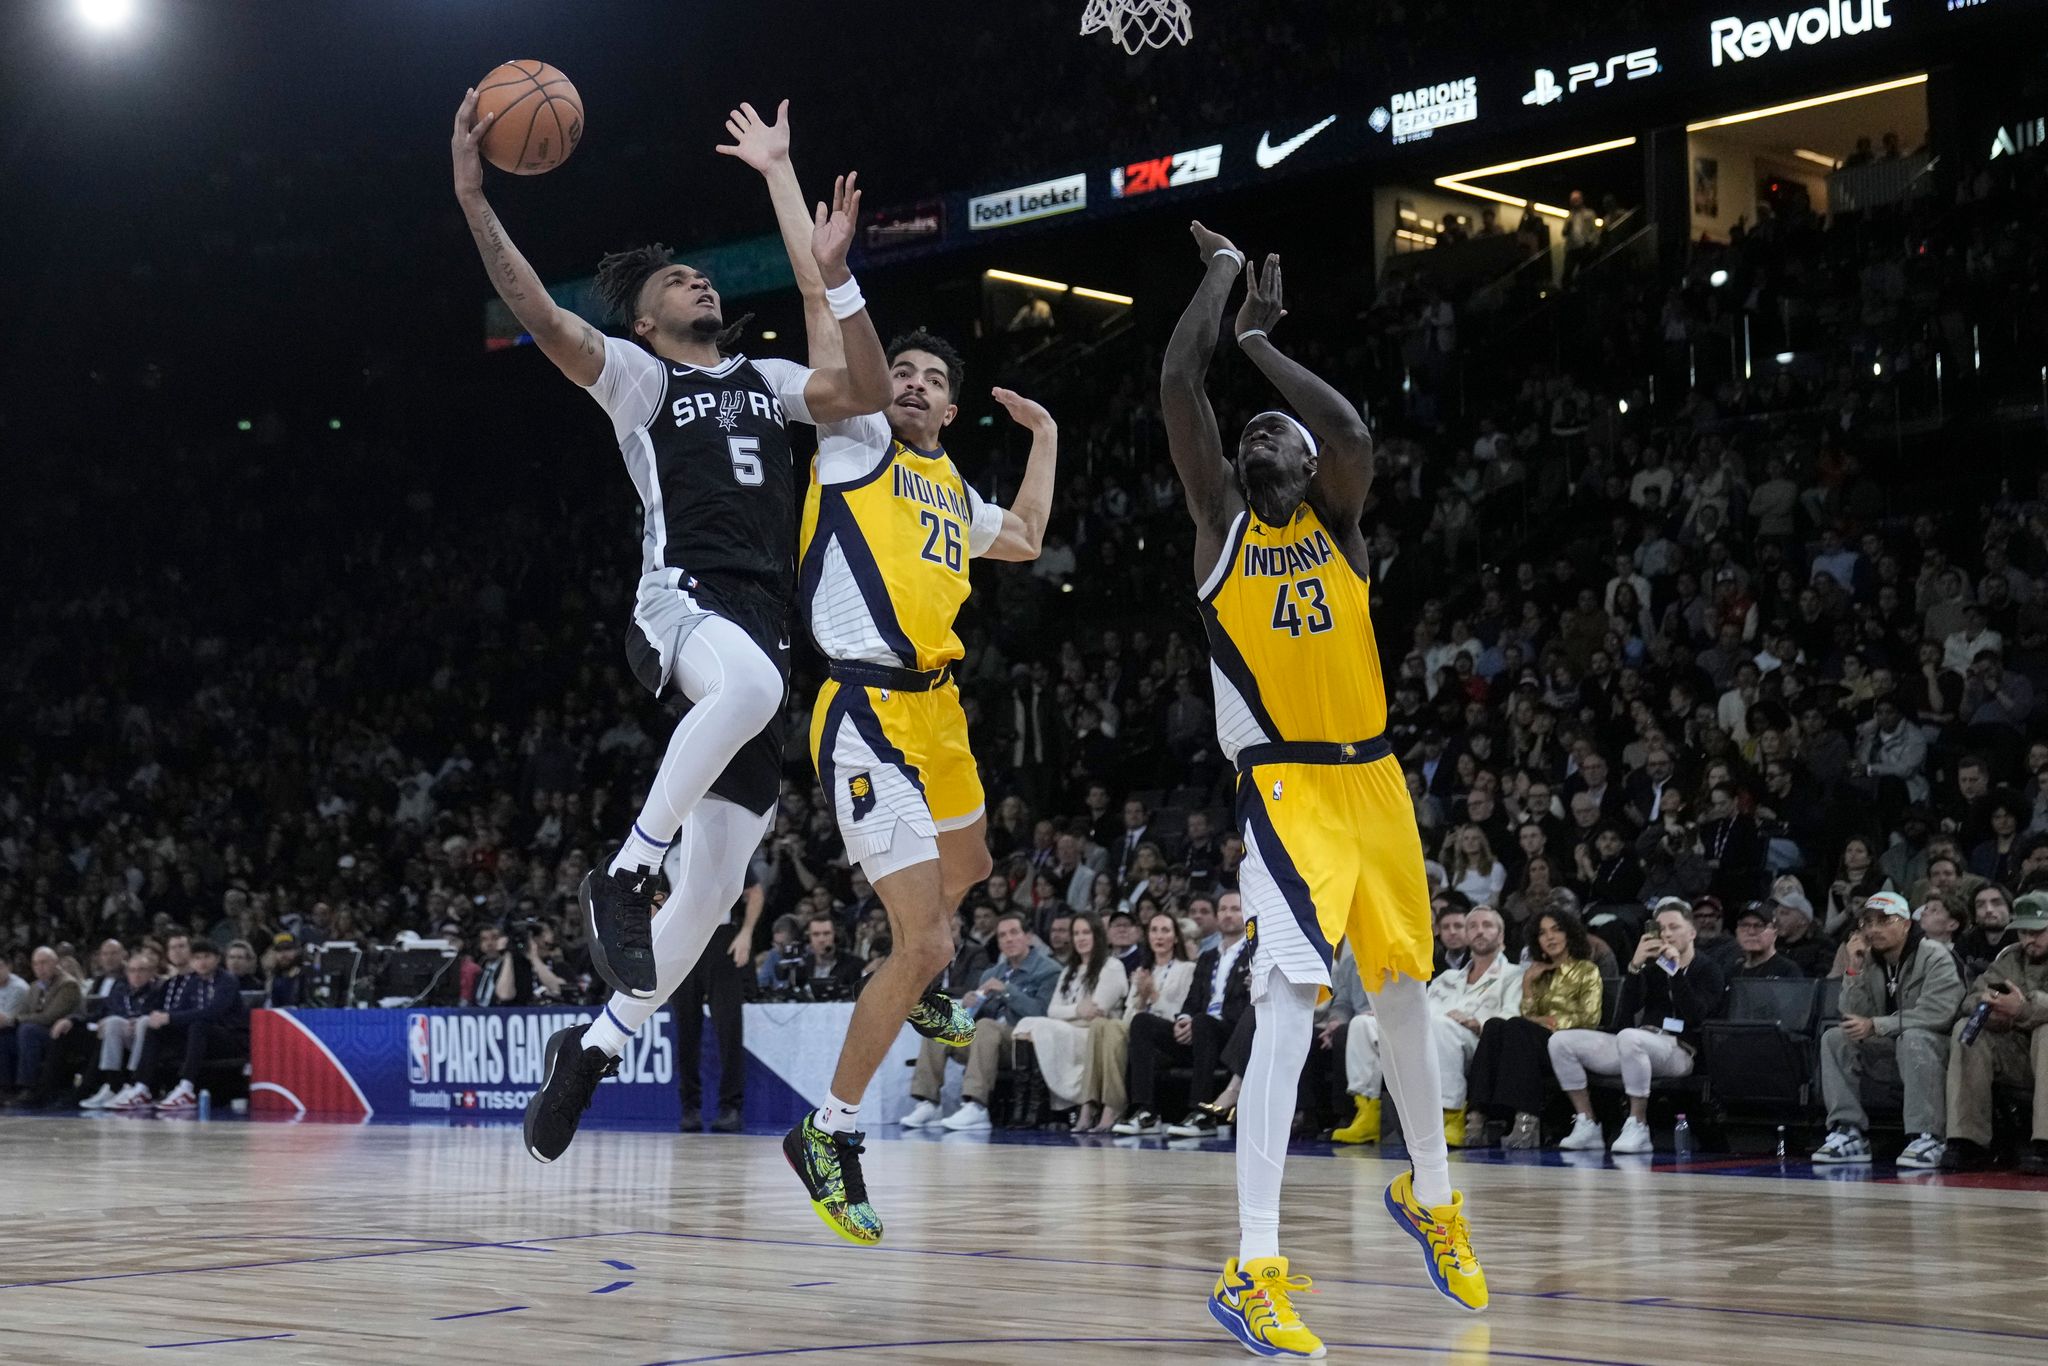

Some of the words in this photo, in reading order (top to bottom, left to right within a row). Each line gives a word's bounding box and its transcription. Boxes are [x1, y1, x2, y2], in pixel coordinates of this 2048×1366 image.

[1710, 0, 1892, 67] Revolut
[1391, 76, 1477, 114] PARIONS
[1568, 47, 1658, 93] PS5
[975, 198, 1012, 224] Foot
[1019, 186, 1080, 212] Locker
[672, 390, 785, 432] SPURS
[726, 435, 766, 487] 5
[893, 463, 971, 527] INDIANA
[919, 509, 962, 574] 26
[1271, 577, 1334, 638] 43
[430, 1014, 504, 1084] PARIS
[600, 1011, 673, 1084] 025
